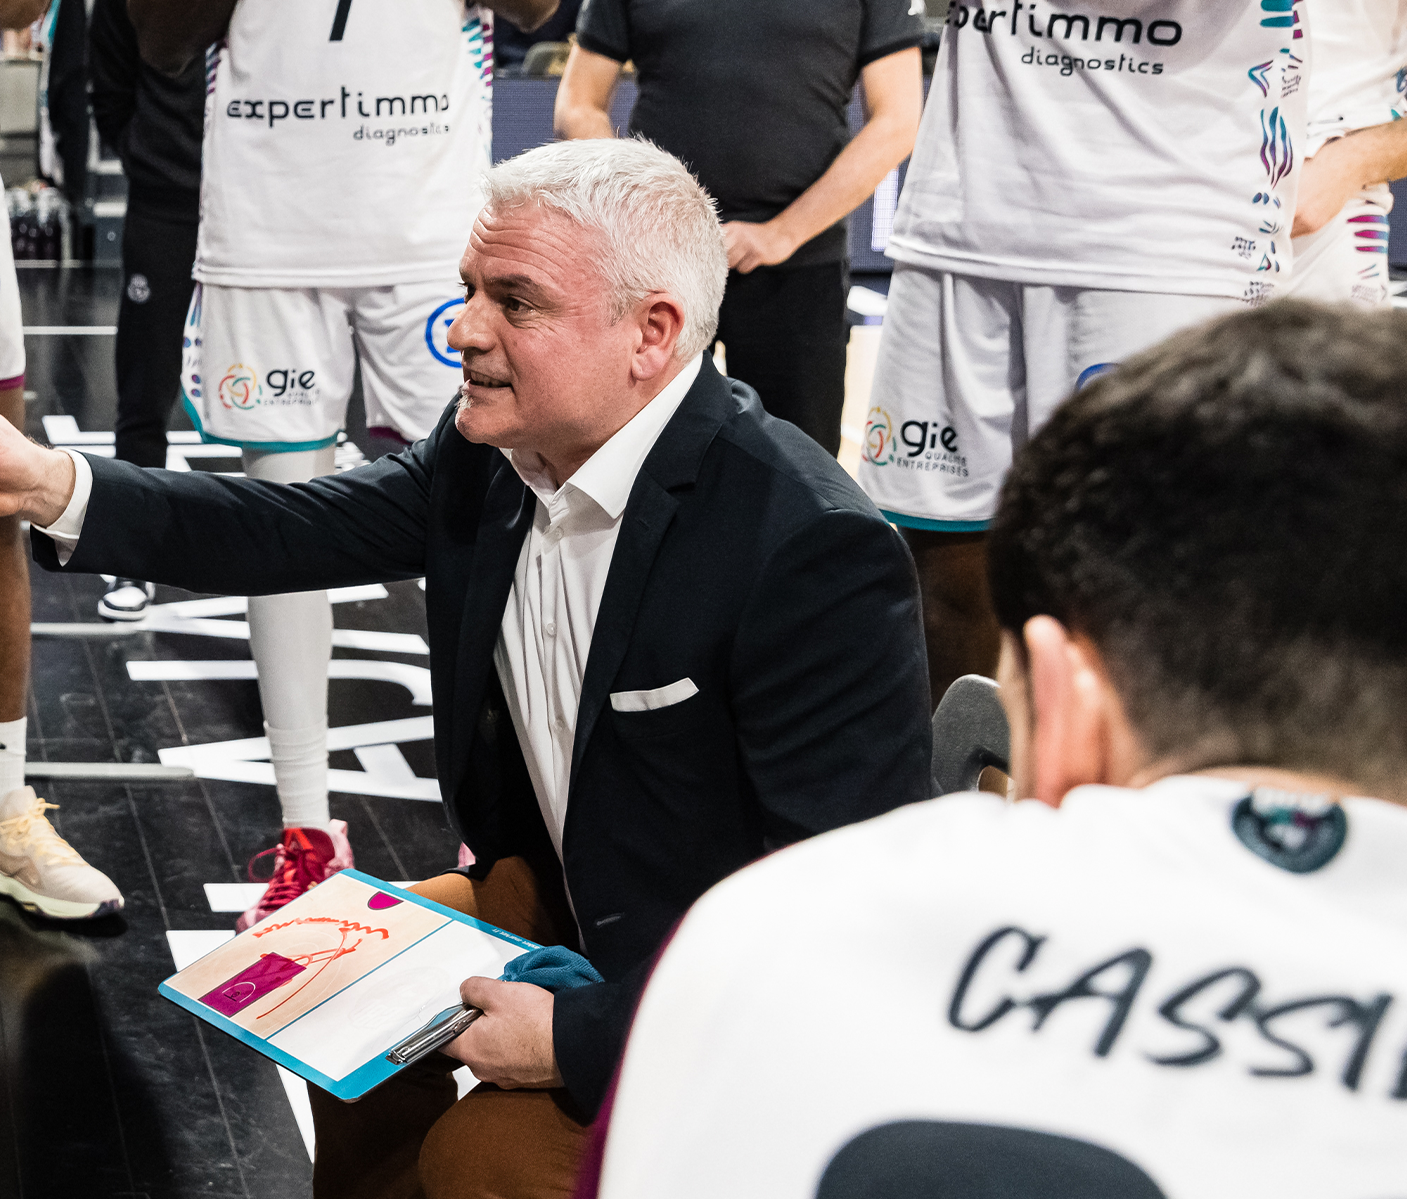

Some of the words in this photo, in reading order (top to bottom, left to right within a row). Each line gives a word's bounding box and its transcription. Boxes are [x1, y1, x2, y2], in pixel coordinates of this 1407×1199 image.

[1021, 46, 1165, 77] diagnostics
[266, 369, 316, 397] gie
[900, 420, 958, 458] gie
[947, 925, 1407, 1101] CASSI
